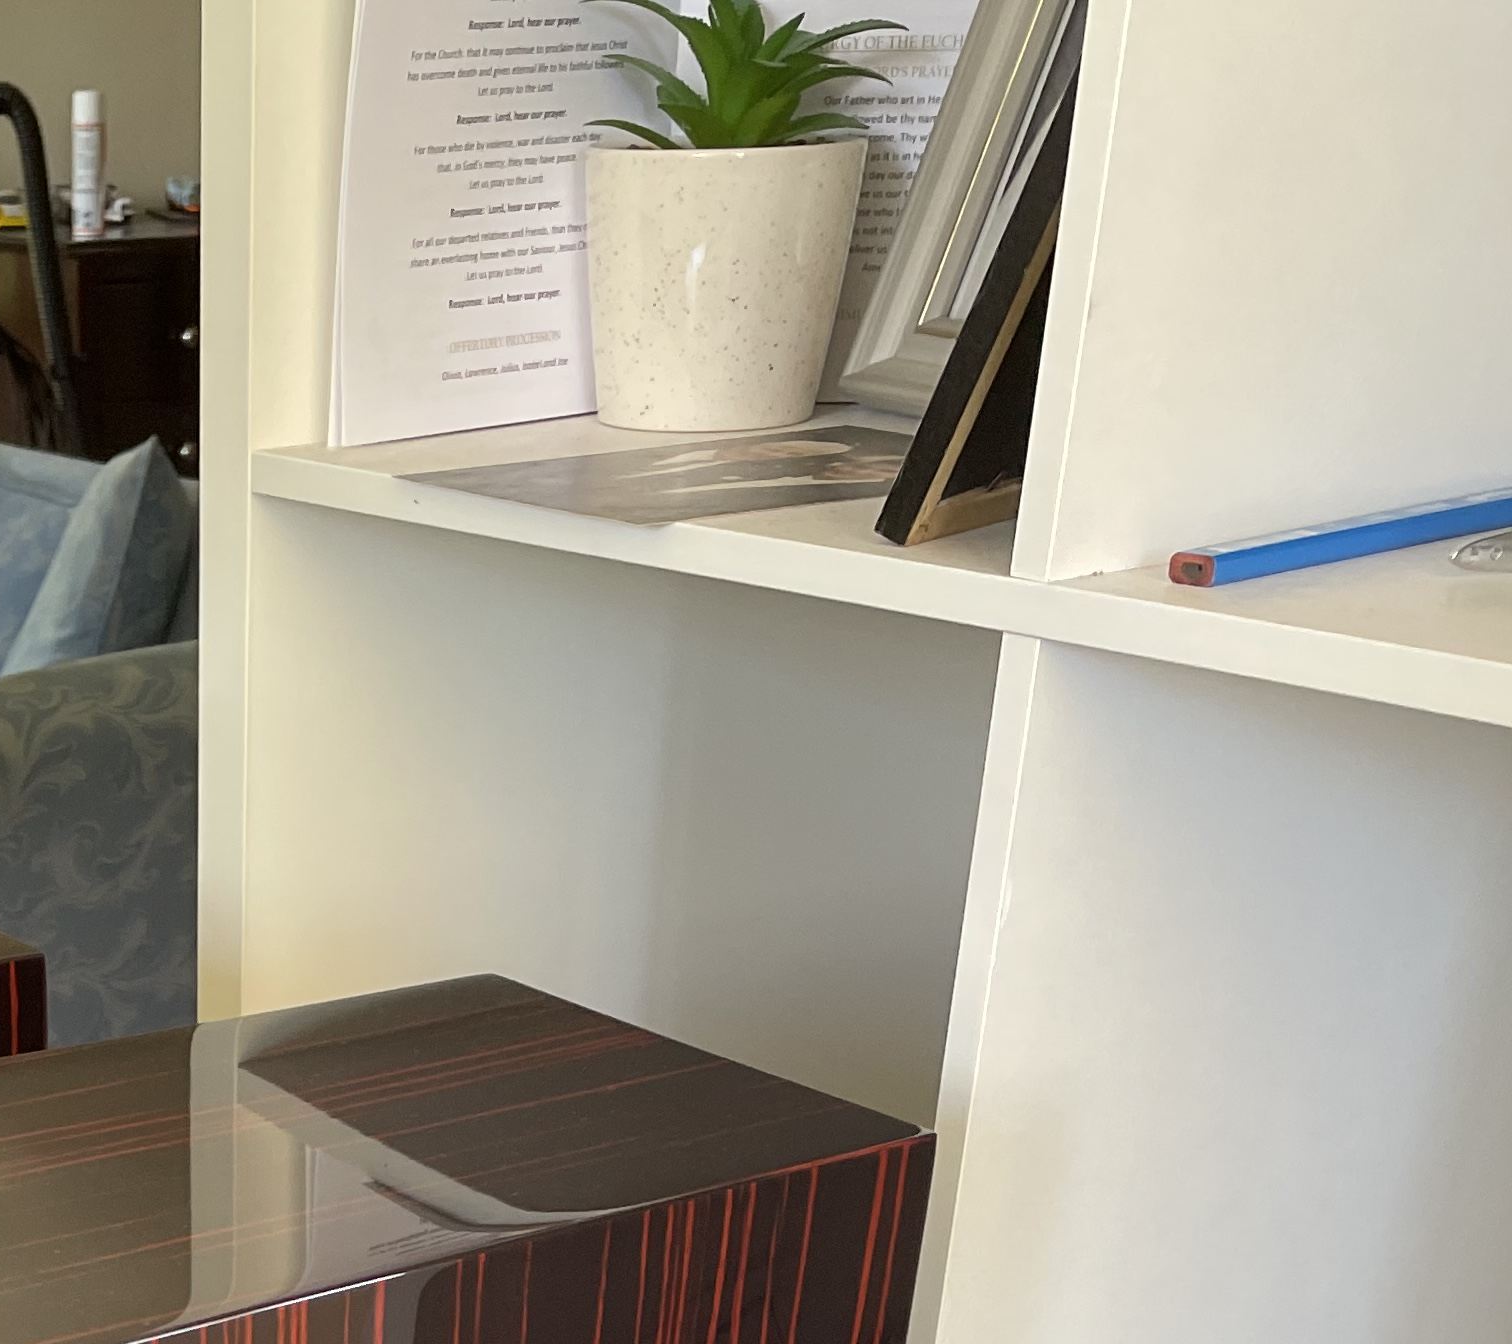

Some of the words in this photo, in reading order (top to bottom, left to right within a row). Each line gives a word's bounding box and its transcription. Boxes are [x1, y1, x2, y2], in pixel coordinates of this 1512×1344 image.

[864, 36, 883, 49] OF
[889, 35, 918, 49] THE
[824, 96, 841, 105] Our
[844, 95, 875, 105] Father
[878, 95, 899, 105] who
[902, 96, 914, 104] art
[917, 96, 925, 104] in
[886, 115, 897, 124] be
[900, 114, 915, 125] thy
[901, 133, 917, 143] Thy
